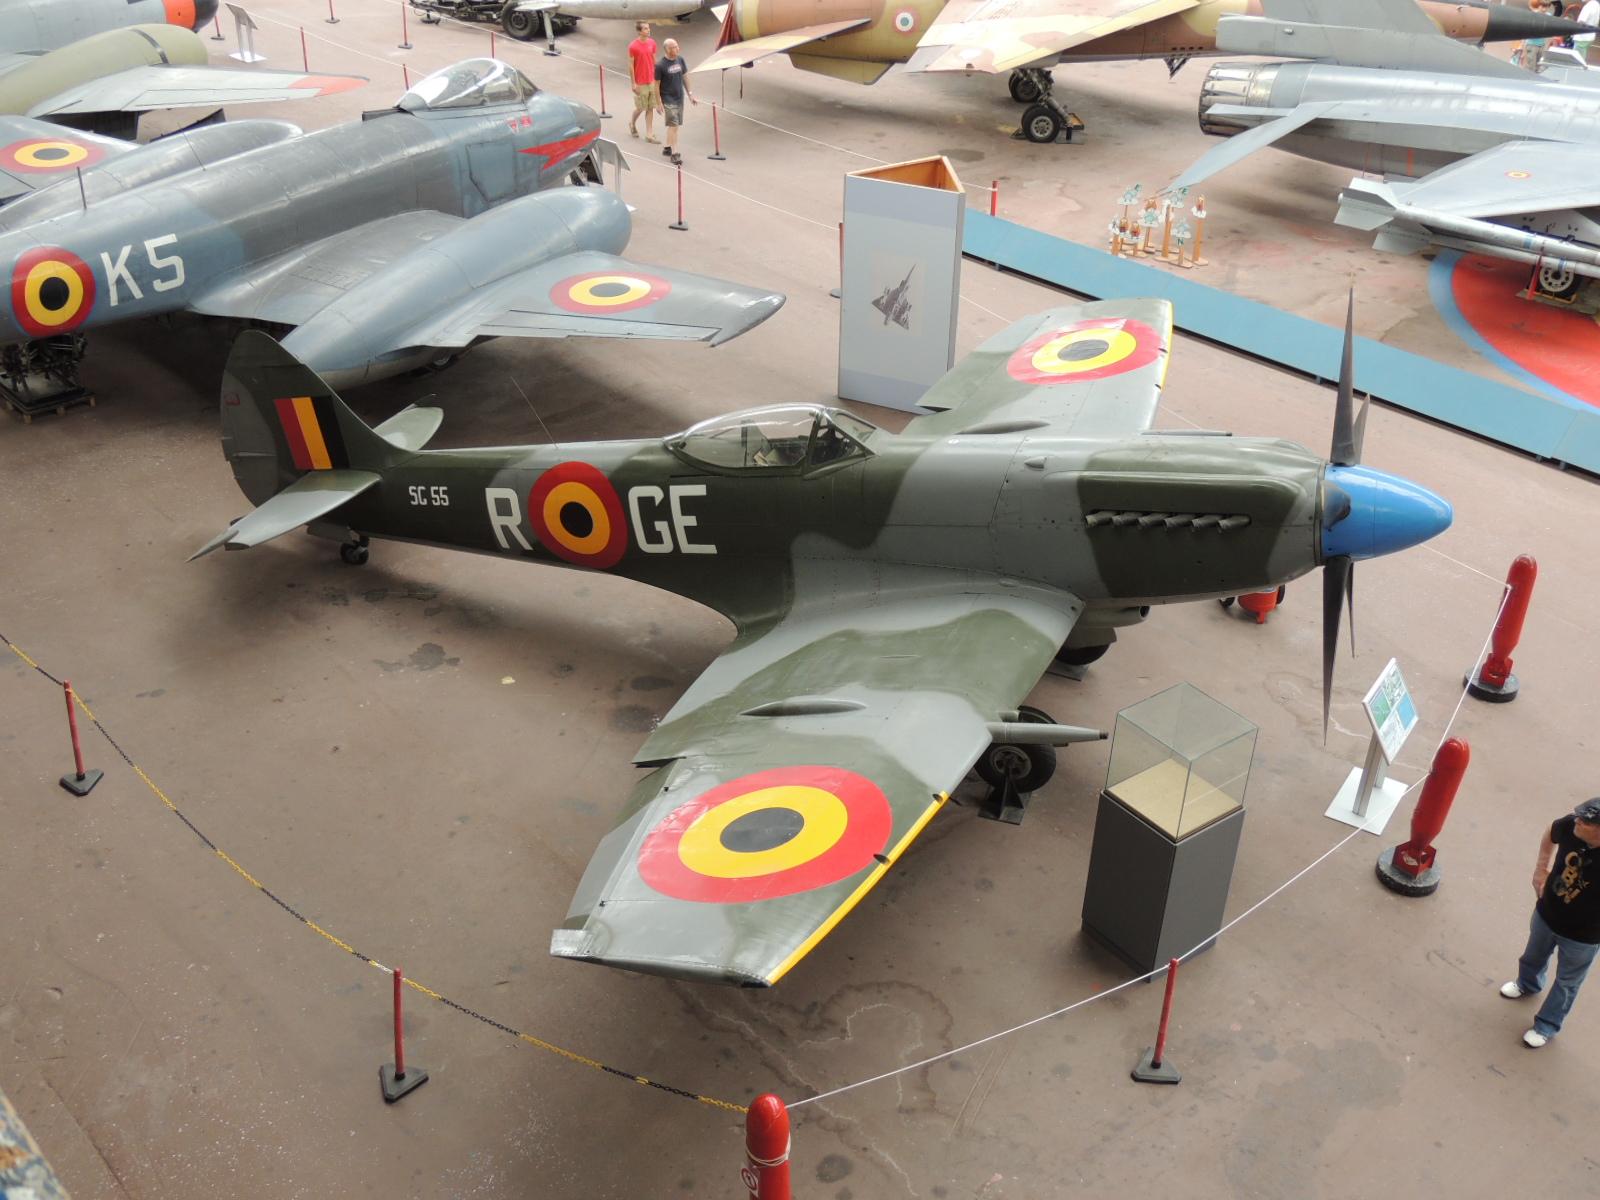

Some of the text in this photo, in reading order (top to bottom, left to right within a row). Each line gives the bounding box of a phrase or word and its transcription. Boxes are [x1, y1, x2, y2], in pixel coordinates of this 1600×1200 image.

[100, 233, 185, 307] K5
[430, 486, 450, 507] 55
[485, 484, 718, 555] R GE
